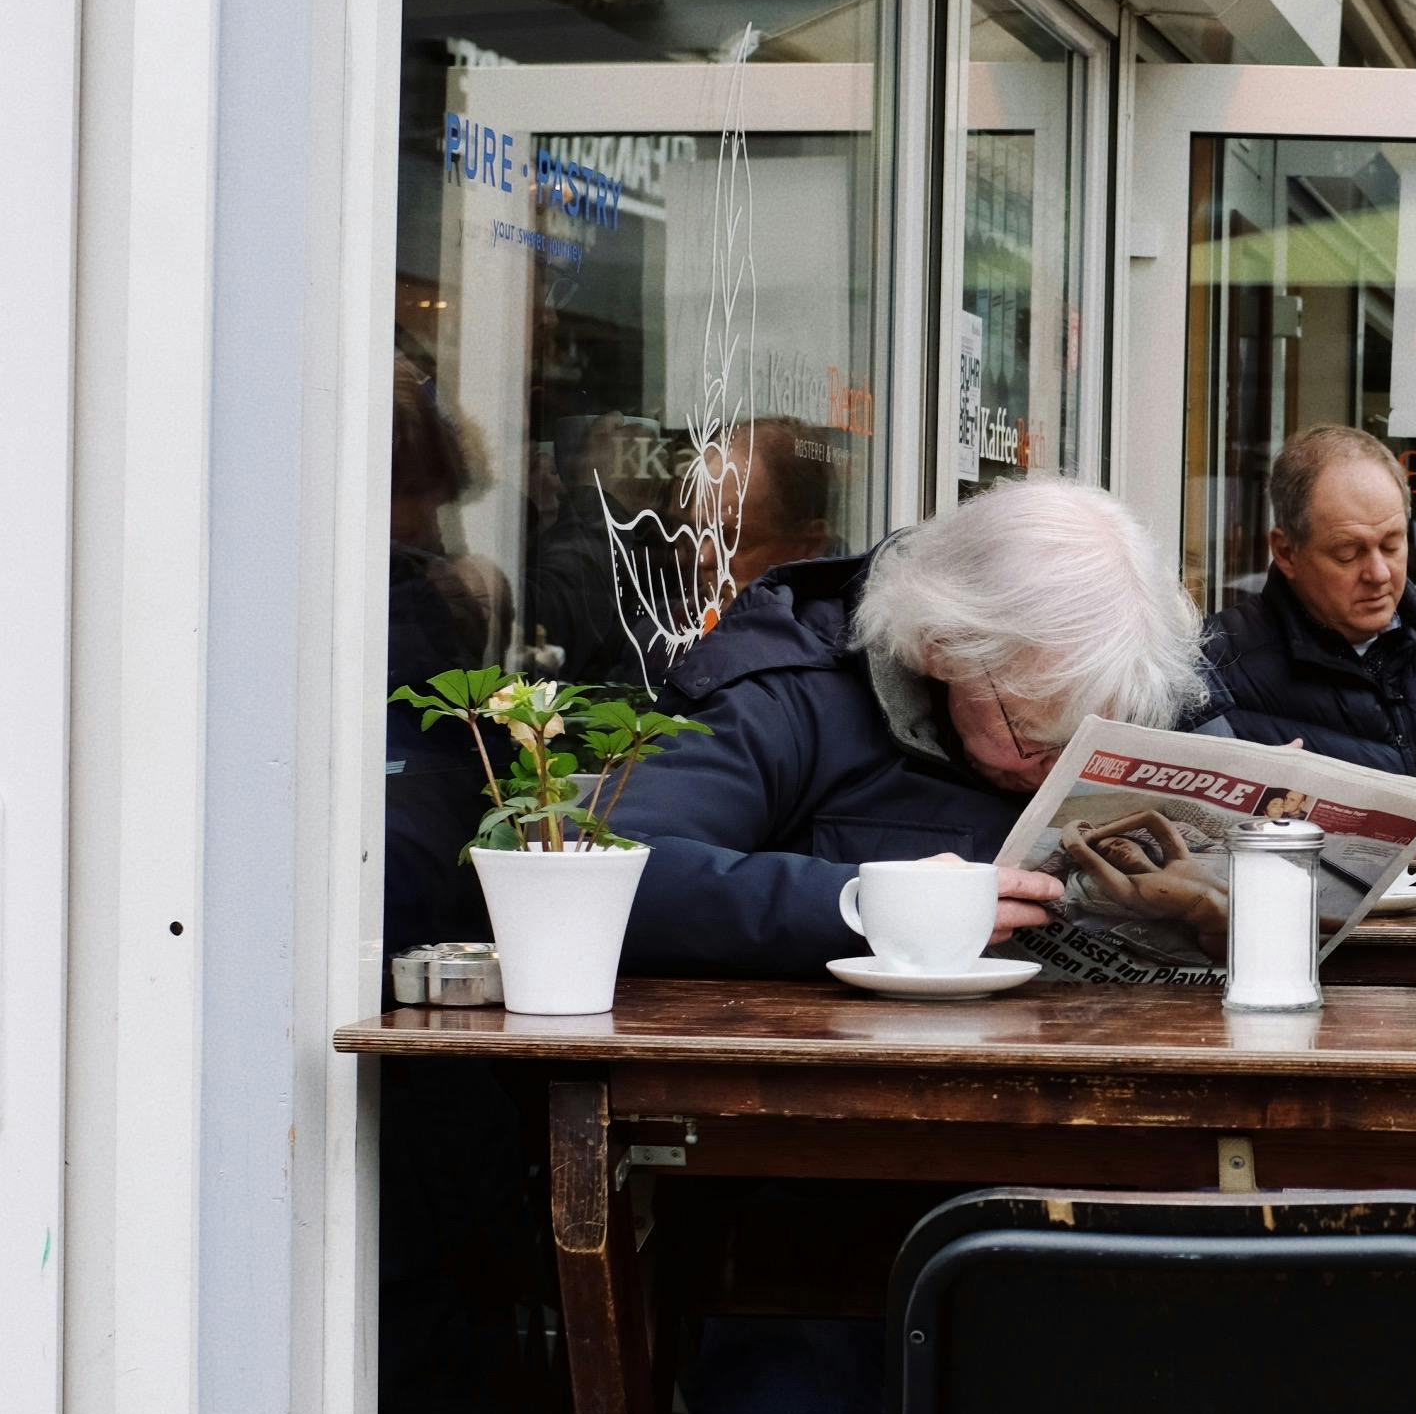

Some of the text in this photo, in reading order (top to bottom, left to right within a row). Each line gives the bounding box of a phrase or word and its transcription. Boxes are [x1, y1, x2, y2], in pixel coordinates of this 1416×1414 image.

[445, 112, 513, 193] PURE
[536, 147, 624, 231] PASTRY
[493, 219, 515, 247] your
[1085, 754, 1257, 806] EXPRESS PEOPLE
[1062, 927, 1121, 969] lässt
[1116, 960, 1149, 984] im
[1149, 966, 1227, 987] Playbo
